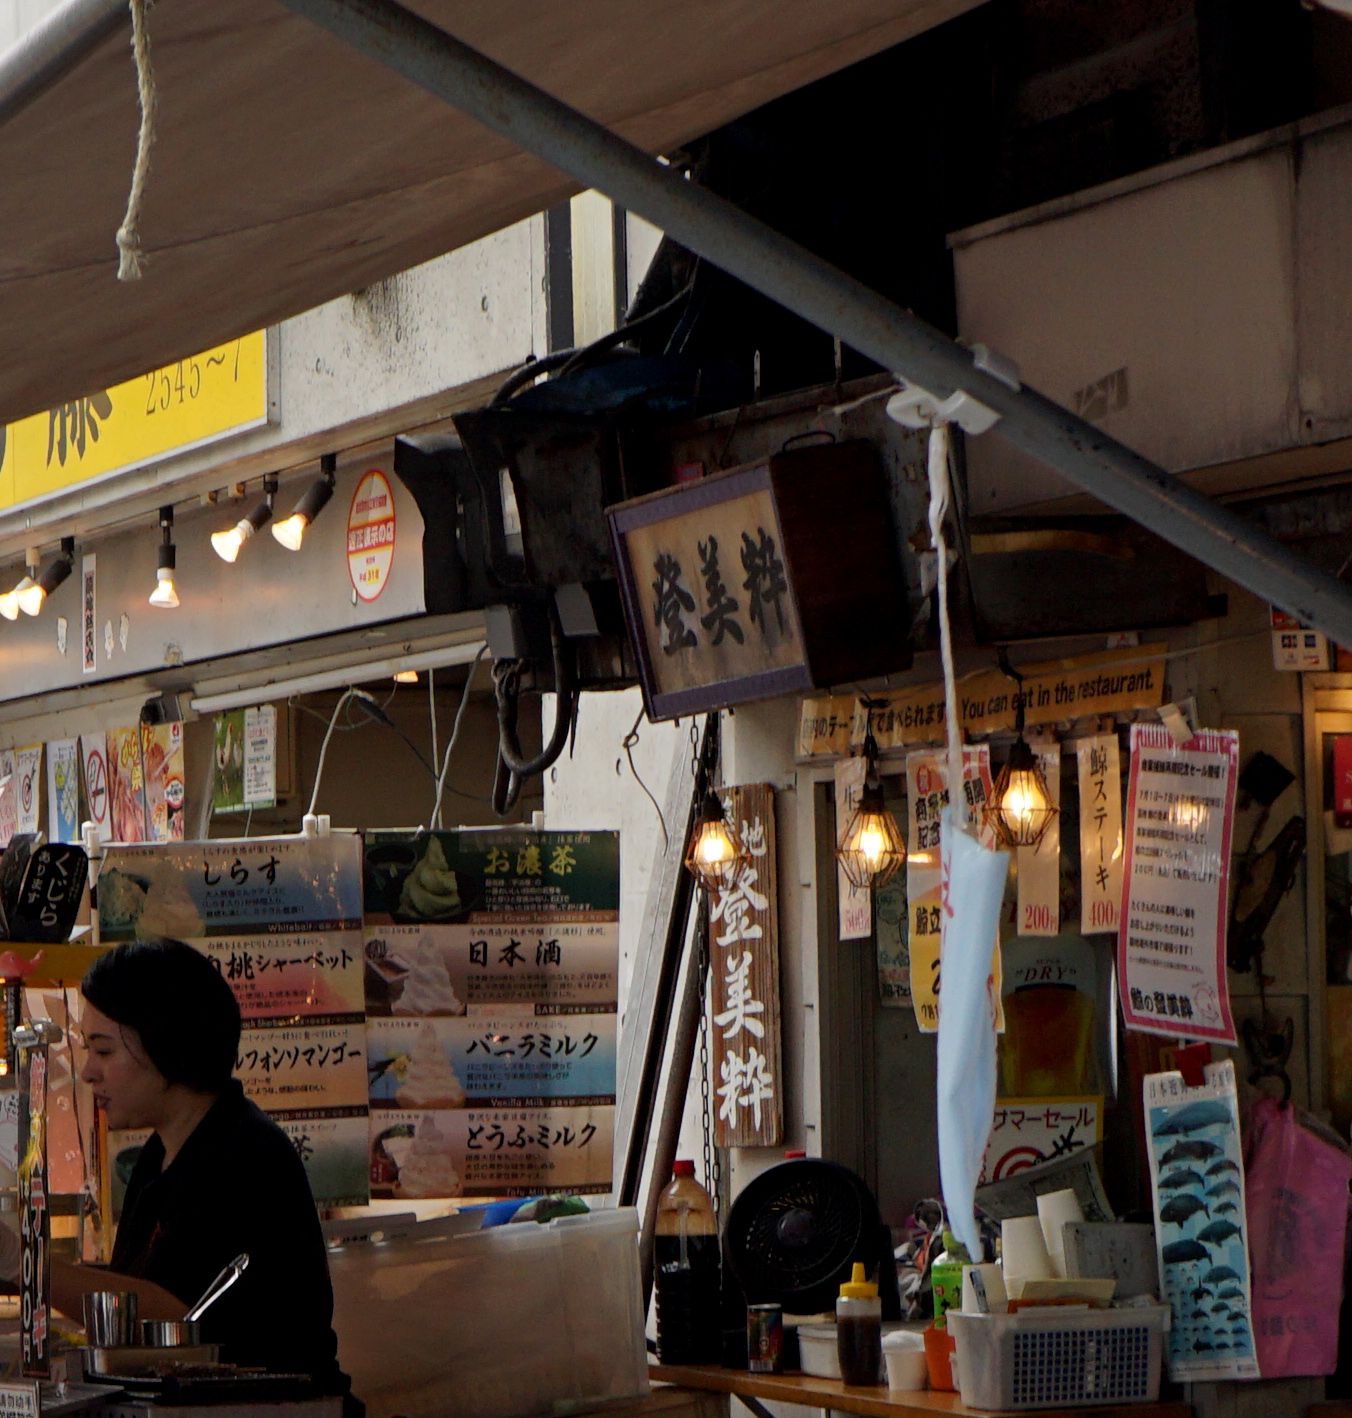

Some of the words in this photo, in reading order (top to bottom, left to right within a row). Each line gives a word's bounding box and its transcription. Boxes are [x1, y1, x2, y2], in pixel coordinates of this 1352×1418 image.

[962, 698, 984, 720] You
[1037, 684, 1050, 706] in
[1054, 682, 1074, 704] the
[1076, 667, 1154, 702] restaurant.
[1089, 744, 1111, 894] 鯨ステーキ
[203, 855, 281, 887] しらす
[483, 844, 577, 877] お濃茶
[27, 851, 52, 905] あります
[39, 852, 70, 928] くじら
[468, 938, 562, 967] 日本酒
[465, 1032, 599, 1058] バニラミルク
[465, 1122, 598, 1151] とうふミルク
